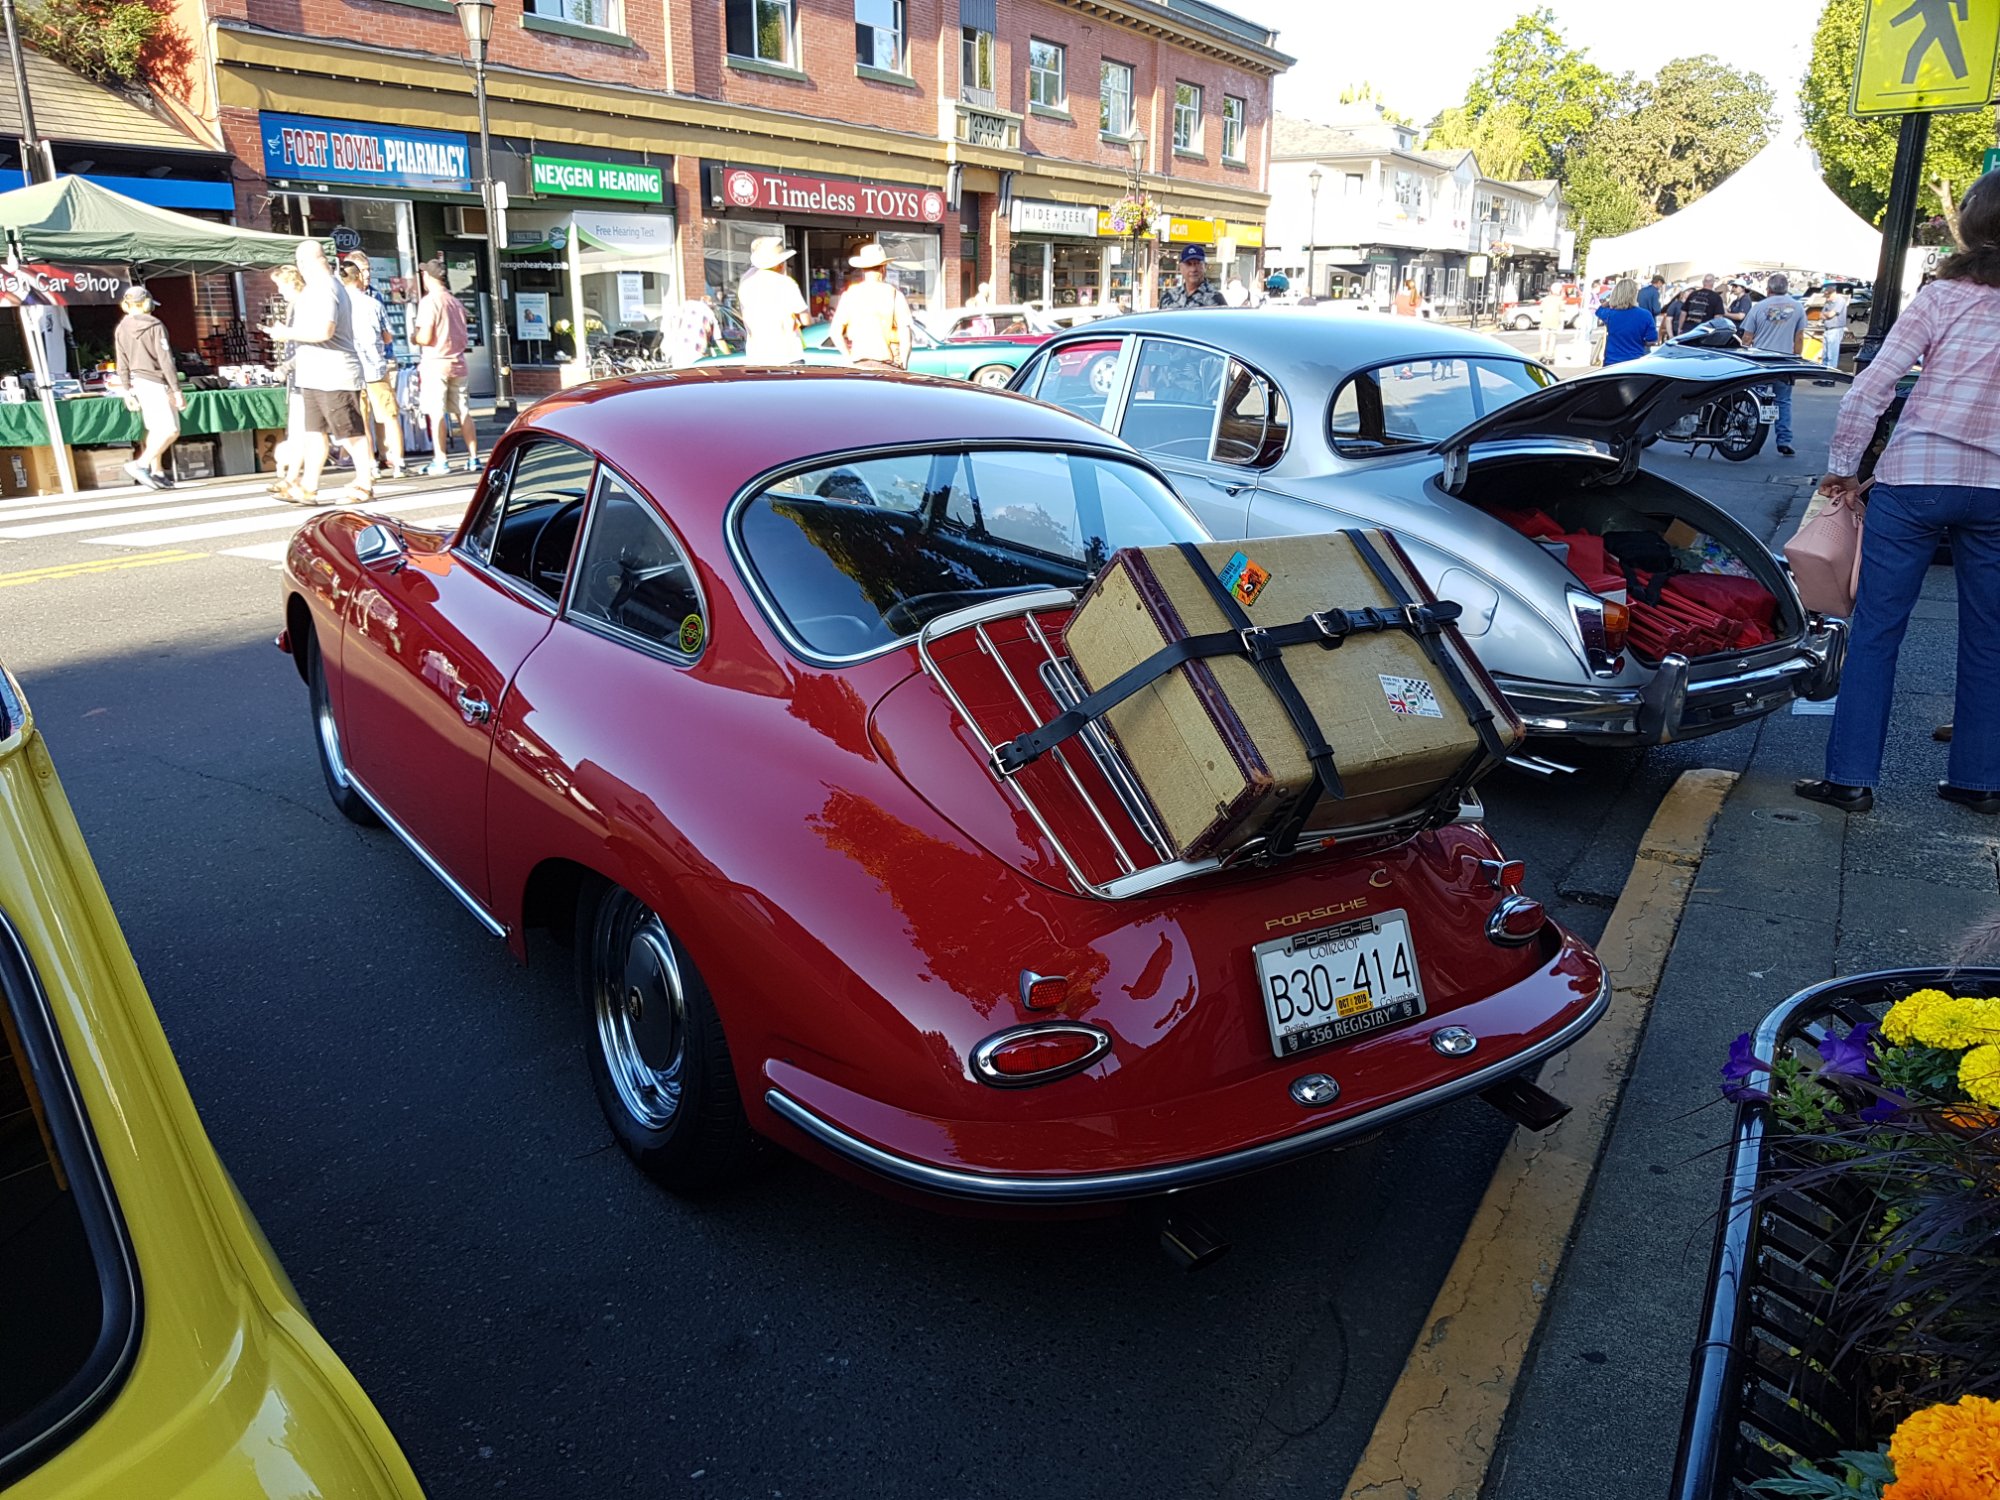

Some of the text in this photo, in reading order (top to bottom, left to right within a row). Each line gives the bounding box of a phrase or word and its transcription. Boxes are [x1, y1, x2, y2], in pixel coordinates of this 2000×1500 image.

[281, 128, 466, 178] FORT ROYAL PHARMACY
[534, 163, 659, 193] NEXGEN HEARING
[763, 177, 919, 218] Timeless TOYS
[1025, 207, 1050, 221] HIDE
[1062, 210, 1086, 223] SEEK
[1042, 222, 1070, 231] COFFEE
[596, 224, 655, 240] Free Hearing Test
[36, 272, 69, 292] Car
[74, 272, 120, 299] Shop
[1265, 897, 1369, 931] PORSCHE
[1294, 920, 1373, 948] PORSCHE
[1308, 937, 1360, 960] Collector
[1269, 942, 1412, 1025] B30-414
[1338, 998, 1350, 1010] OCT
[1354, 993, 1367, 1006] 2019
[1311, 1027, 1333, 1045] 356
[1335, 1009, 1392, 1037] REGISTRY
